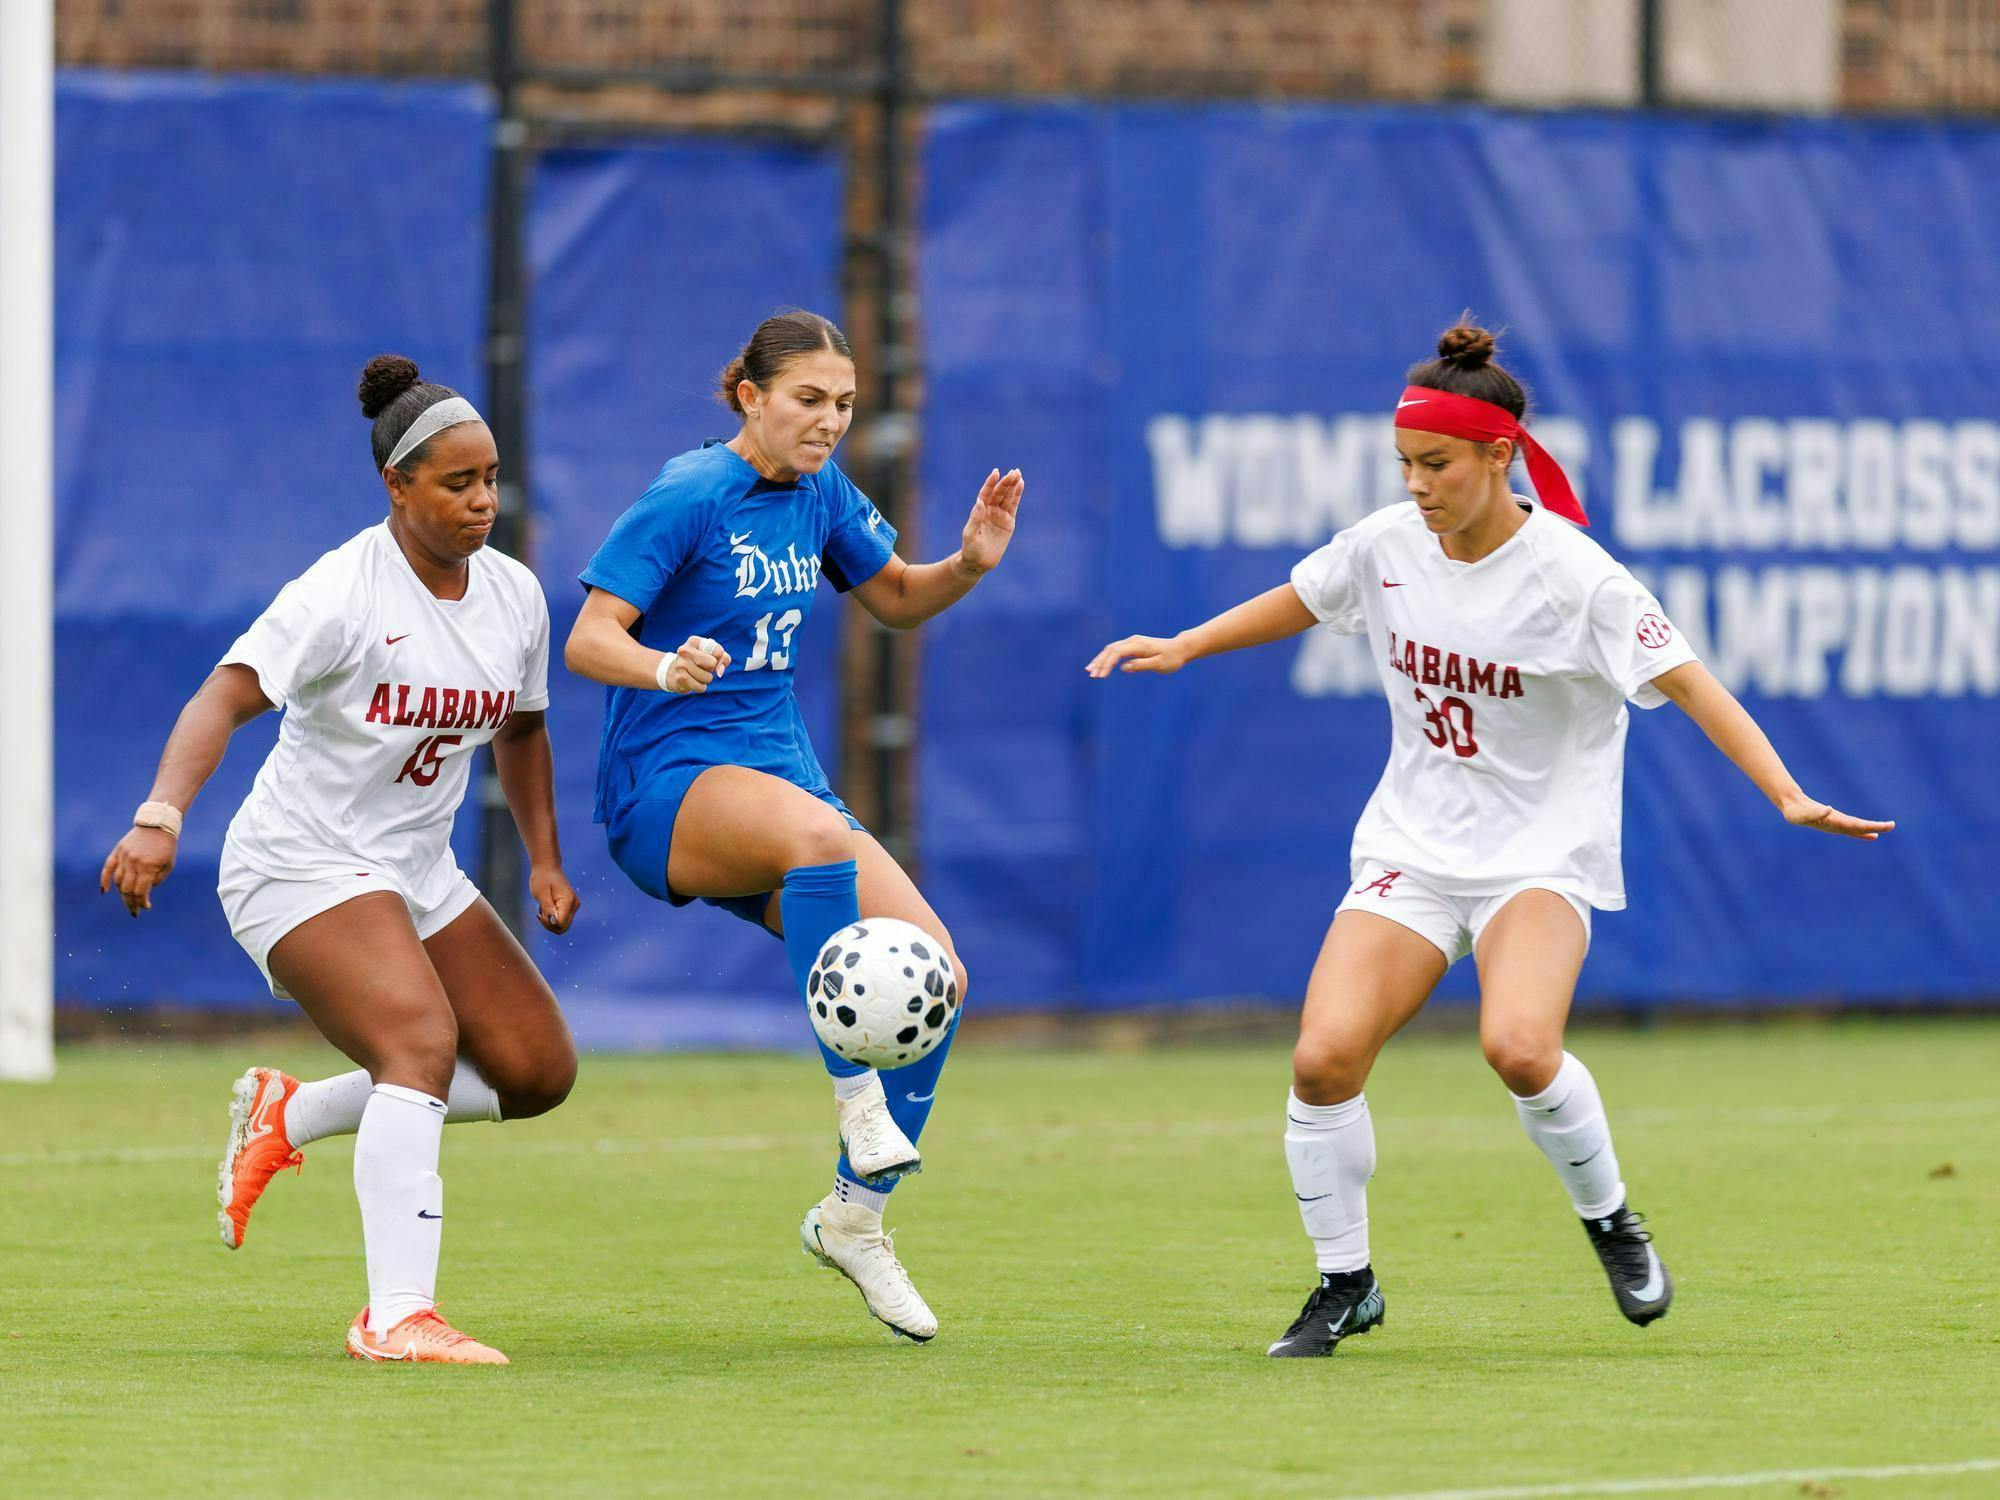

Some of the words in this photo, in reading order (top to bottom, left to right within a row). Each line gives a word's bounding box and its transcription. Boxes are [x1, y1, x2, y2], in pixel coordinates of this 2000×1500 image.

[1610, 415, 2000, 549] LACROSS
[730, 542, 822, 599] Duke
[744, 609, 802, 671] 13
[1630, 562, 2000, 698] AMPION
[1415, 687, 1479, 758] 30
[393, 734, 464, 787] 15
